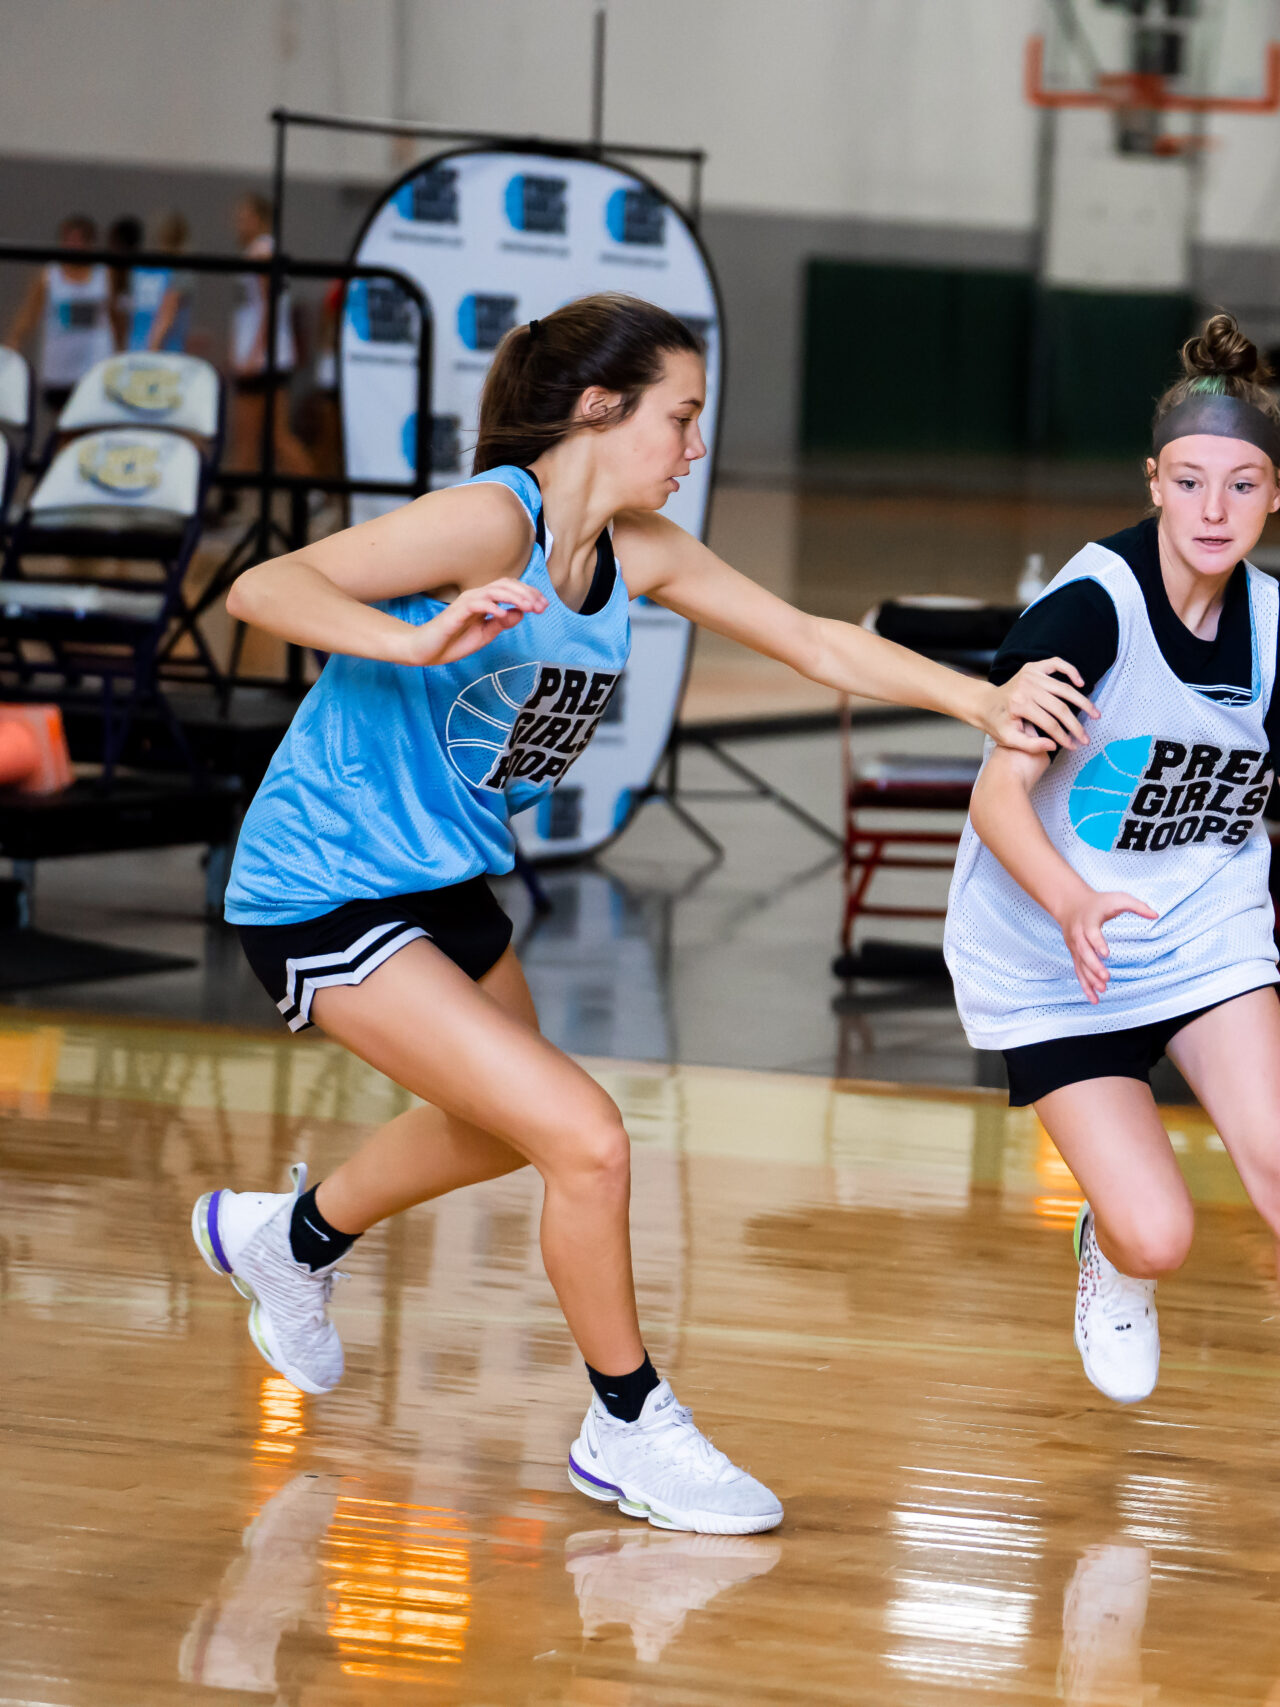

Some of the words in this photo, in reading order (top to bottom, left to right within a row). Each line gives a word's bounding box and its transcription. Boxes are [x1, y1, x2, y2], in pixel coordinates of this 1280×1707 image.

[485, 748, 578, 789] HOOP
[1131, 780, 1269, 818] GIRLS
[1116, 815, 1253, 851] HOOPS
